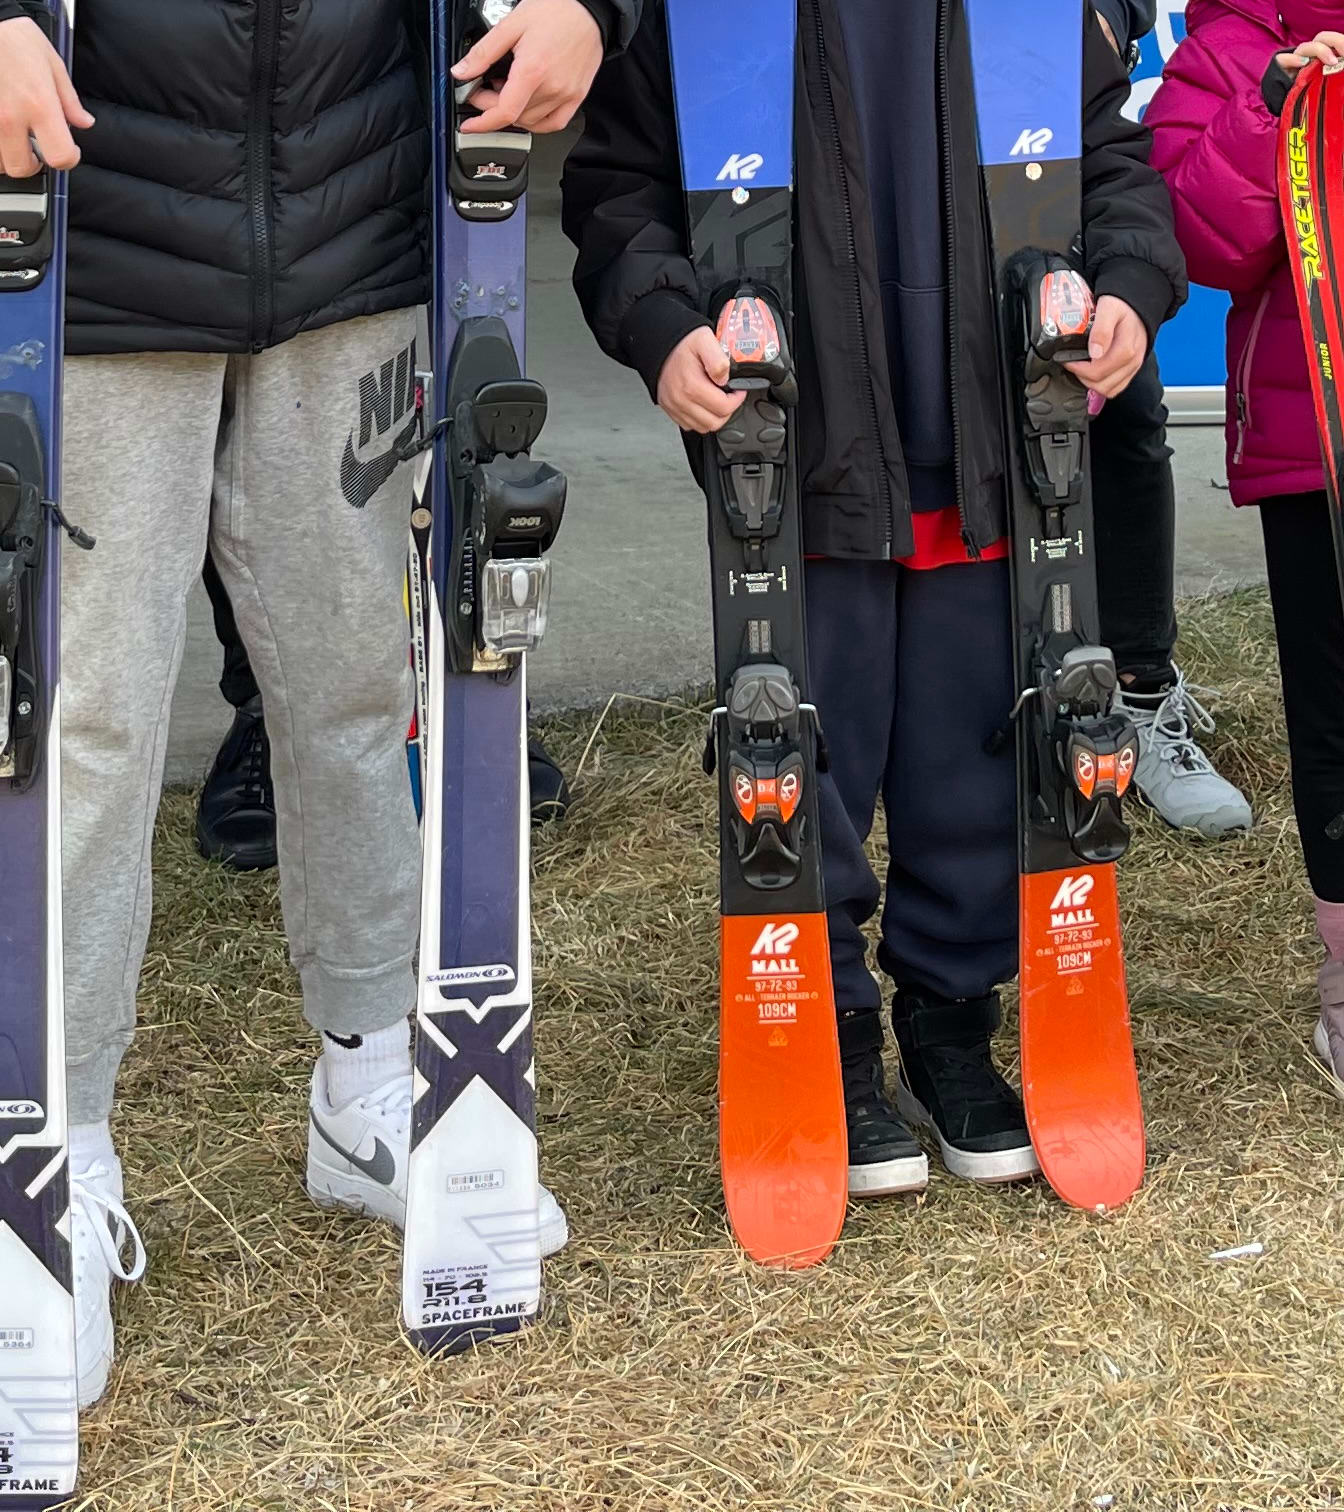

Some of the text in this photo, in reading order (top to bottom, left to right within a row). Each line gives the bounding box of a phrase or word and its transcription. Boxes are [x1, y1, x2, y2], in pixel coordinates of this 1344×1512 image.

[1008, 127, 1054, 157] K2
[715, 152, 764, 181] K2
[1319, 342, 1333, 381] JUNIOR
[509, 515, 541, 527] LOOK
[1049, 873, 1095, 910] K2
[749, 922, 800, 956] K2
[1056, 950, 1092, 969] 109CM
[426, 970, 482, 983] SALOMON
[757, 1002, 797, 1018] 109CM
[422, 1278, 488, 1298] 154
[422, 1293, 488, 1309] R11.8
[422, 1301, 527, 1325] SPACEFRAME
